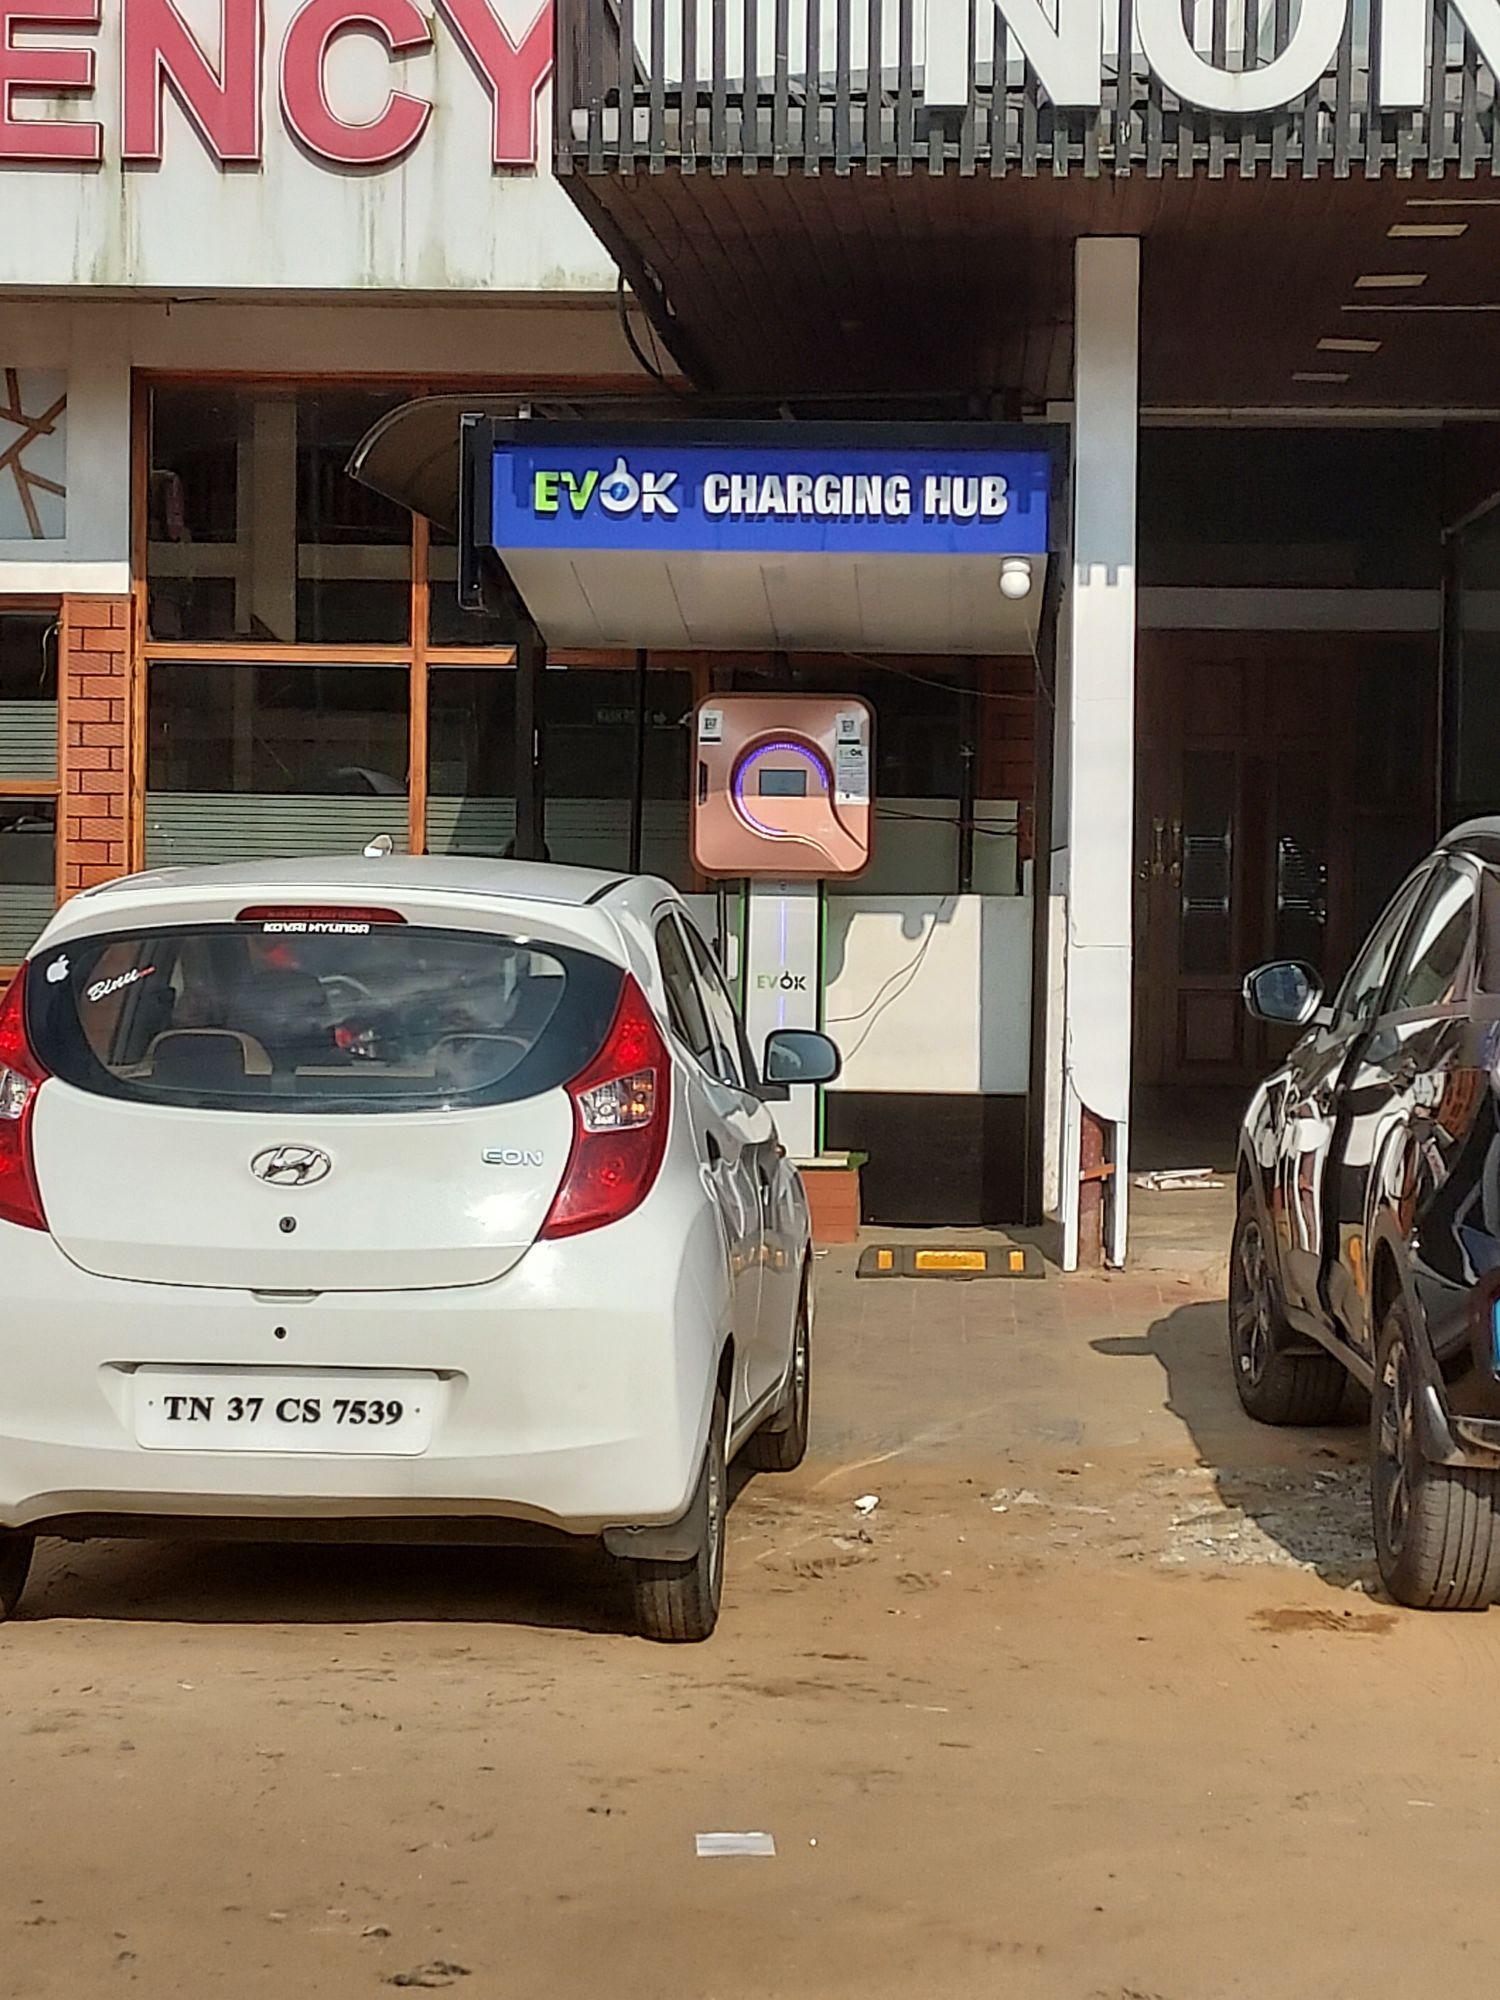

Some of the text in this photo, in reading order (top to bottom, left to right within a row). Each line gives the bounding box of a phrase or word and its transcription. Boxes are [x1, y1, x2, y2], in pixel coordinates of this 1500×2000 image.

[0, 0, 553, 162] ENCY
[534, 457, 1008, 517] EVOK CHARGING HUB
[757, 970, 806, 991] EVOK
[482, 1148, 543, 1167] EON
[164, 1396, 402, 1425] TN 37 CS 7539
